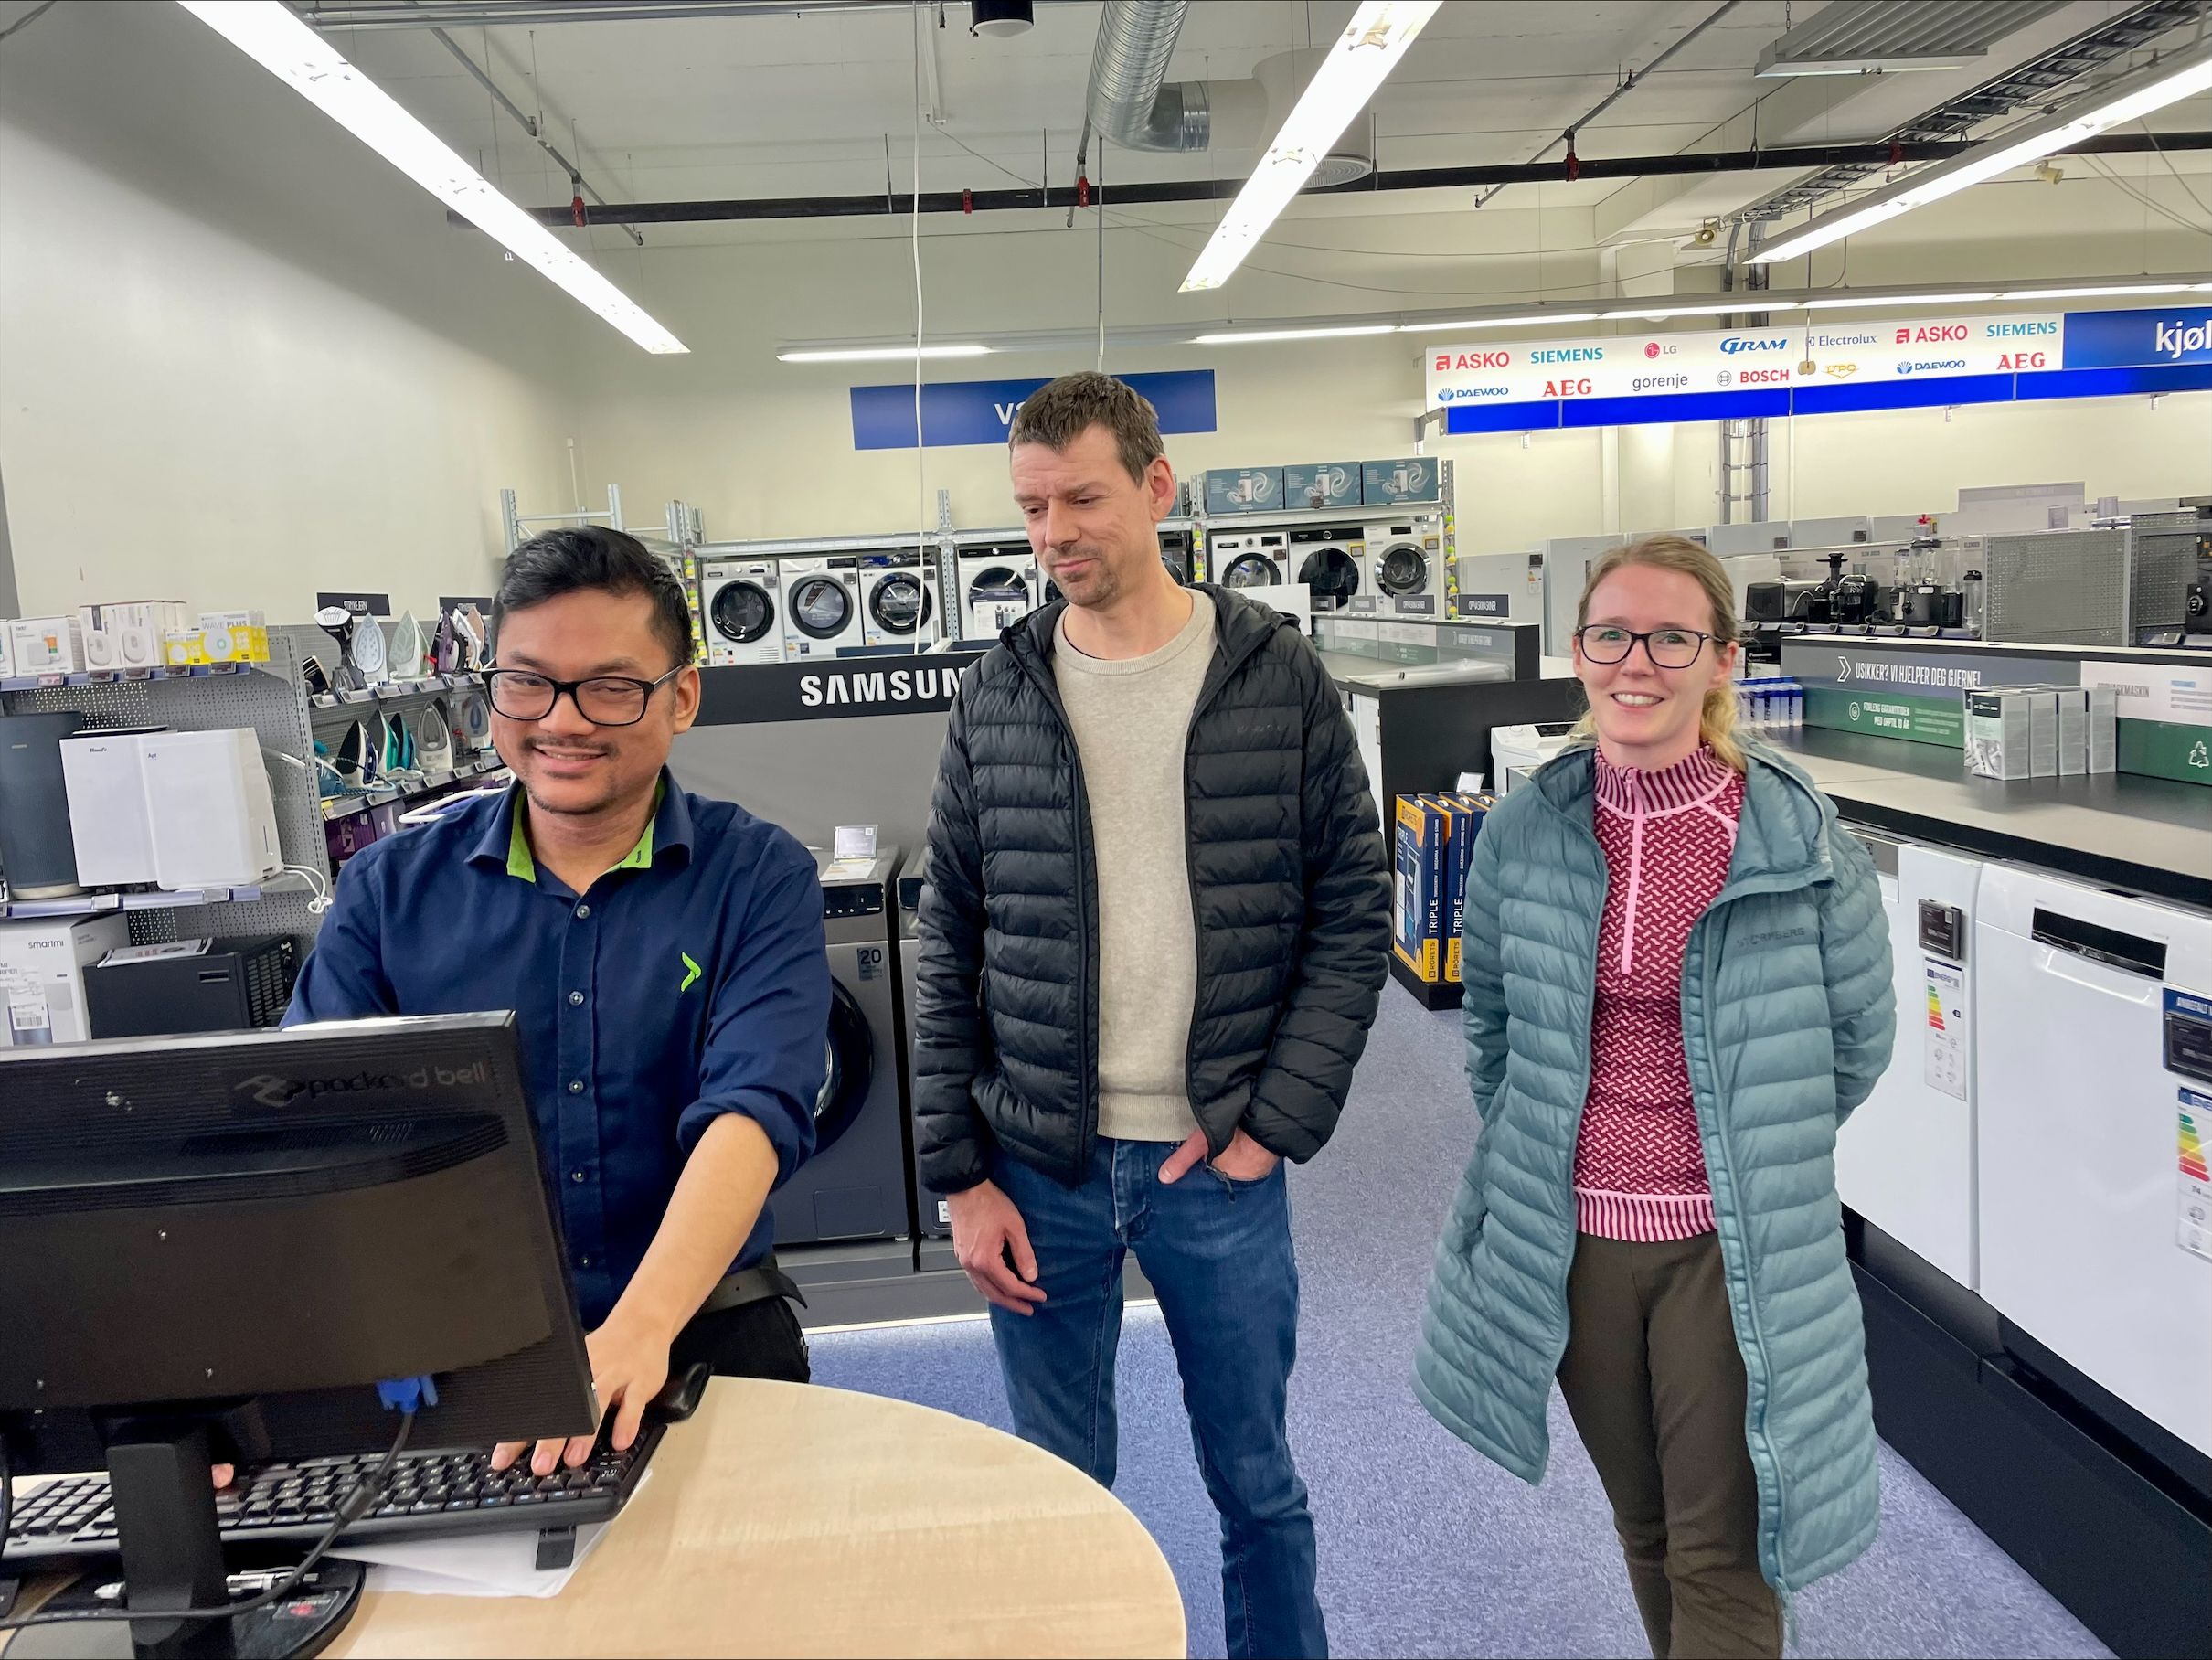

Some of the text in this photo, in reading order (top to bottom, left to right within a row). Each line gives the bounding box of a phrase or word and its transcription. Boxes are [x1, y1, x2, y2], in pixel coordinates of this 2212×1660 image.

[1915, 325, 1968, 343] ASKO
[1986, 321, 2057, 337] SIEMENS
[1719, 337, 1787, 355] GRAM
[1819, 333, 1877, 346] Electrolux
[2156, 319, 2212, 359] kjøl
[1530, 347, 1603, 364] SIEMENS
[1663, 345, 1677, 355] LG
[1456, 351, 1510, 370] ASKO
[1915, 359, 1965, 371] DAEWOO
[1996, 352, 2046, 370] AEG
[1632, 373, 1688, 391] gorenje
[1740, 369, 1789, 384] BOSCH
[1457, 387, 1509, 398] DAEWOO
[1542, 378, 1592, 398] AEG
[227, 620, 248, 629] PLUS
[1856, 662, 1981, 688] USIKKER? VI HJELPER DEG GJERNE!
[801, 667, 967, 706] SAMSUN
[1428, 899, 1439, 934] TRIPLE
[1453, 898, 1463, 934] TRIPLE
[28, 940, 64, 949] smartmi
[860, 948, 882, 964] 20
[308, 1060, 485, 1099] packad bell
